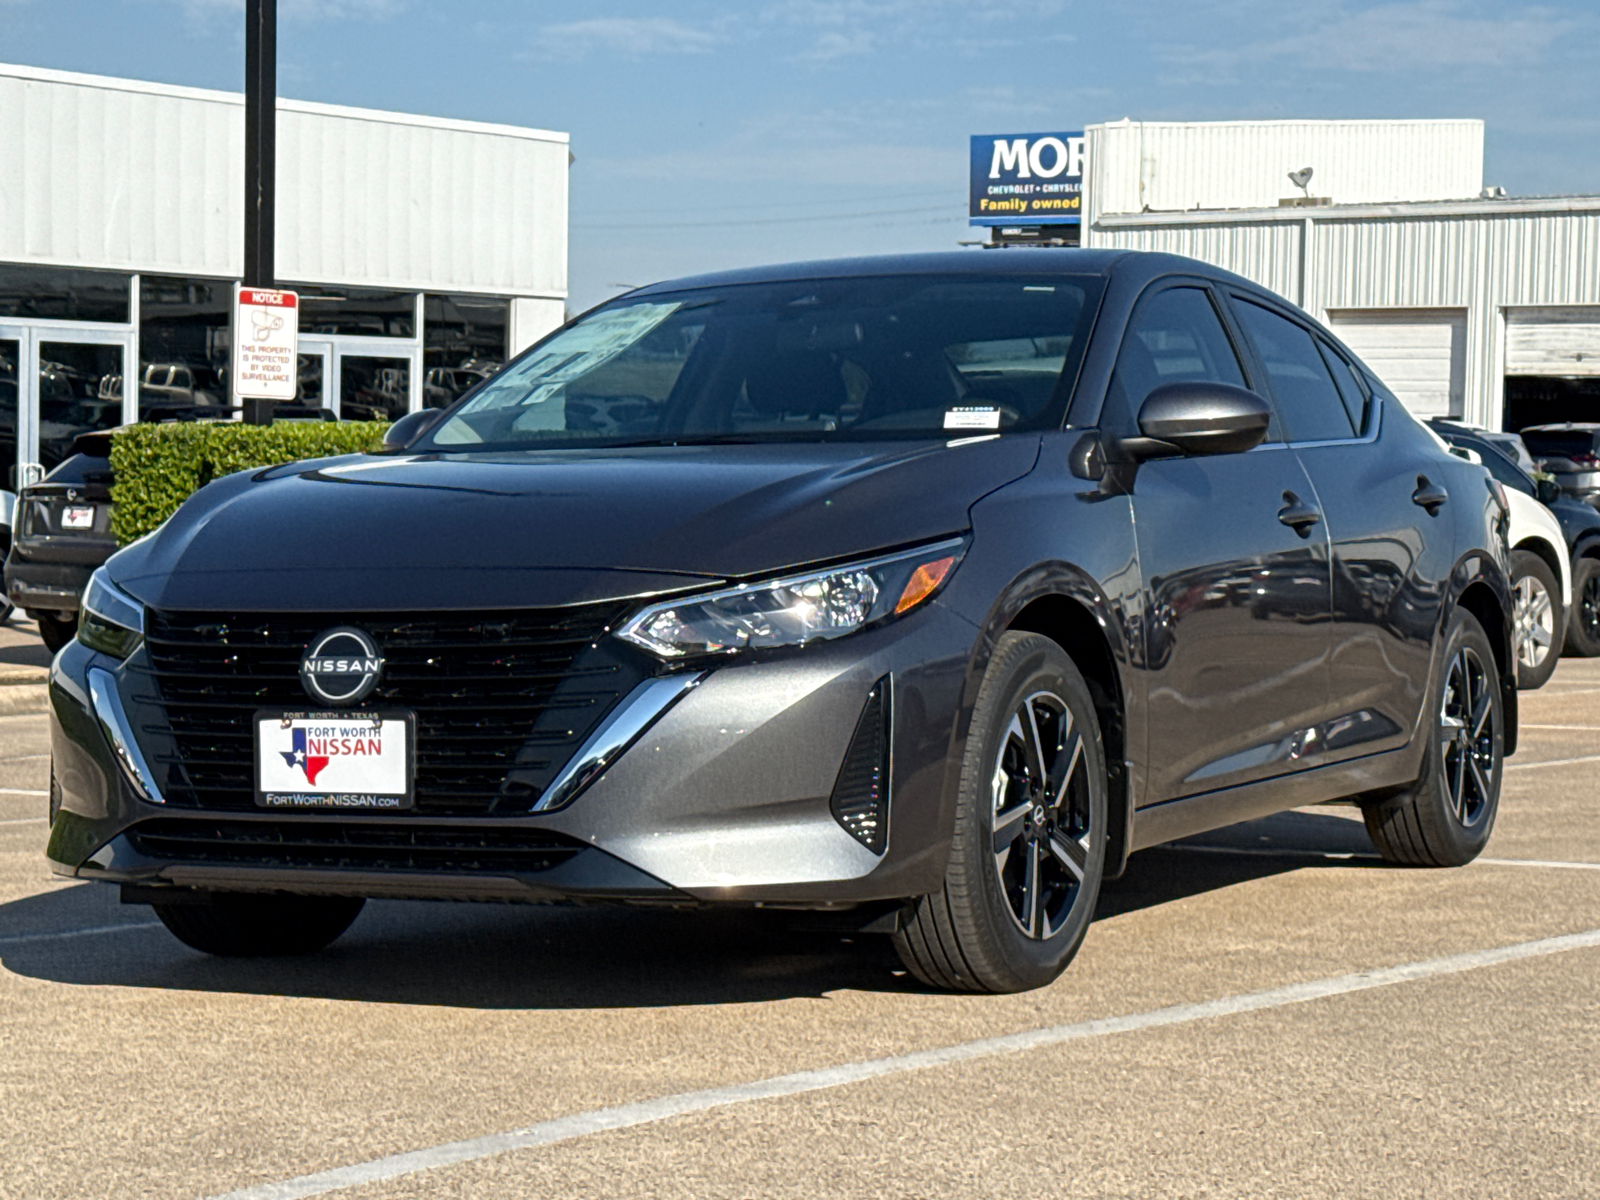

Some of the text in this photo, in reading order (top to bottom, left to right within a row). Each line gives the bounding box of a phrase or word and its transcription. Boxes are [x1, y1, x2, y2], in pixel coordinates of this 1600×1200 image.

[987, 184, 1035, 195] CHEVROLET
[980, 197, 1080, 212] Family owned
[252, 292, 284, 304] NOTICE
[241, 344, 291, 354] THIS PROPERTY
[252, 355, 289, 363] PROTECTED
[262, 364, 282, 372] VIDEO
[241, 372, 290, 382] SURVEILLANCE
[304, 659, 379, 672] NISSAN
[351, 712, 379, 720] TEXAS
[308, 727, 382, 738] FORT WORTH
[308, 738, 382, 756] NISSAN
